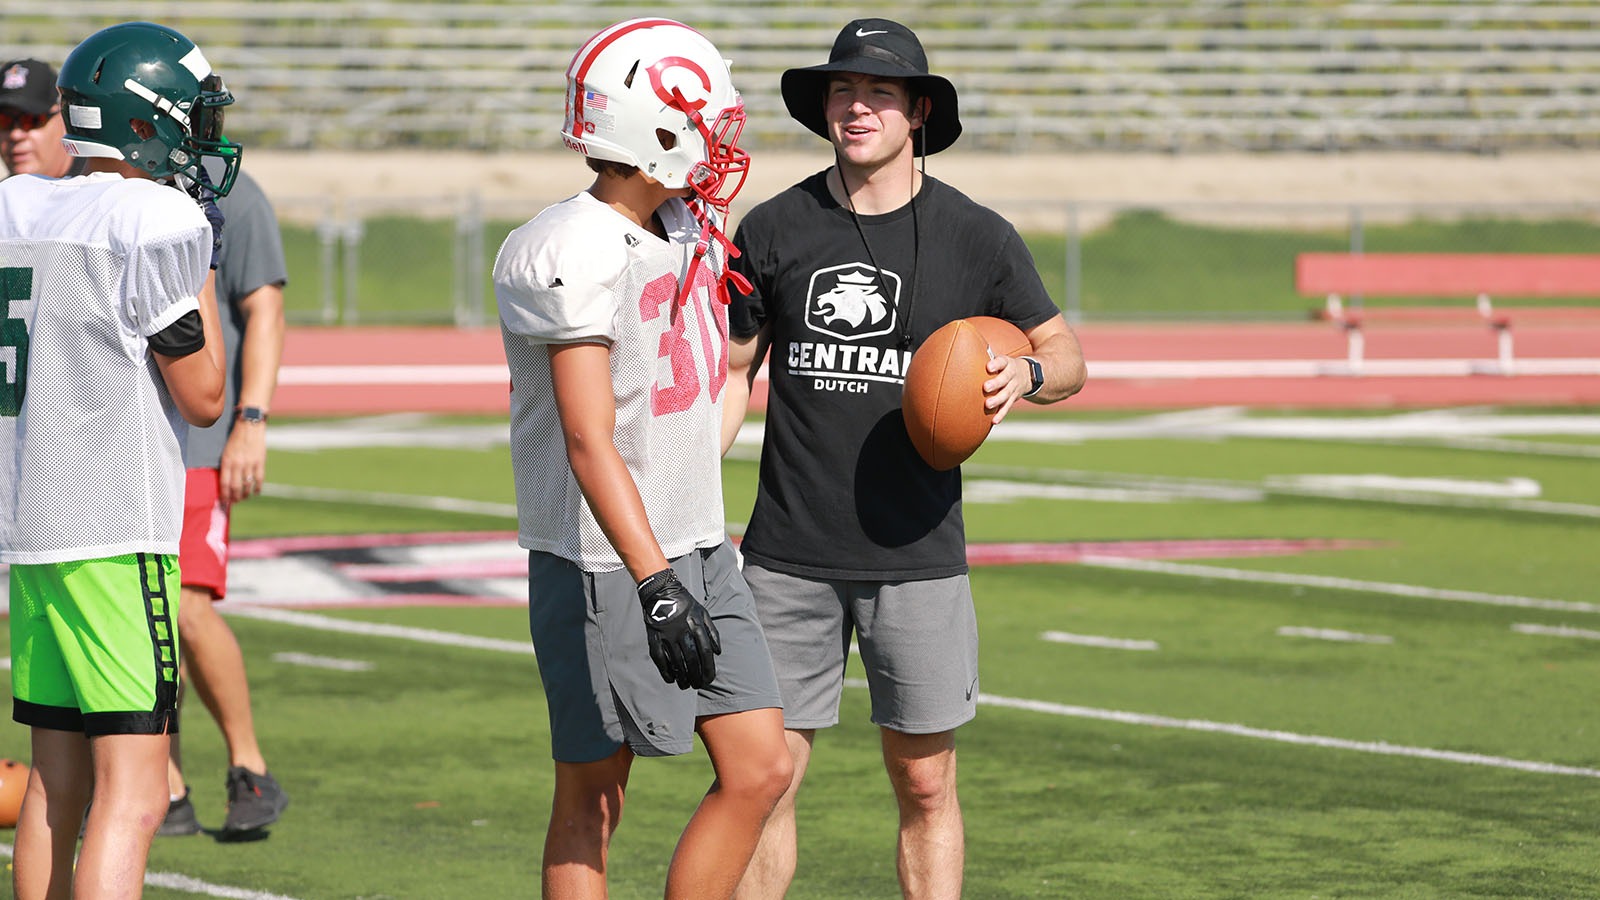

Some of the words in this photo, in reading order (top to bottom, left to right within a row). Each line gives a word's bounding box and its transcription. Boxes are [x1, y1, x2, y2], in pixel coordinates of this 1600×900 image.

[645, 56, 711, 112] C
[0, 267, 33, 417] 5
[639, 260, 729, 417] 30
[814, 379, 868, 393] DUTCH
